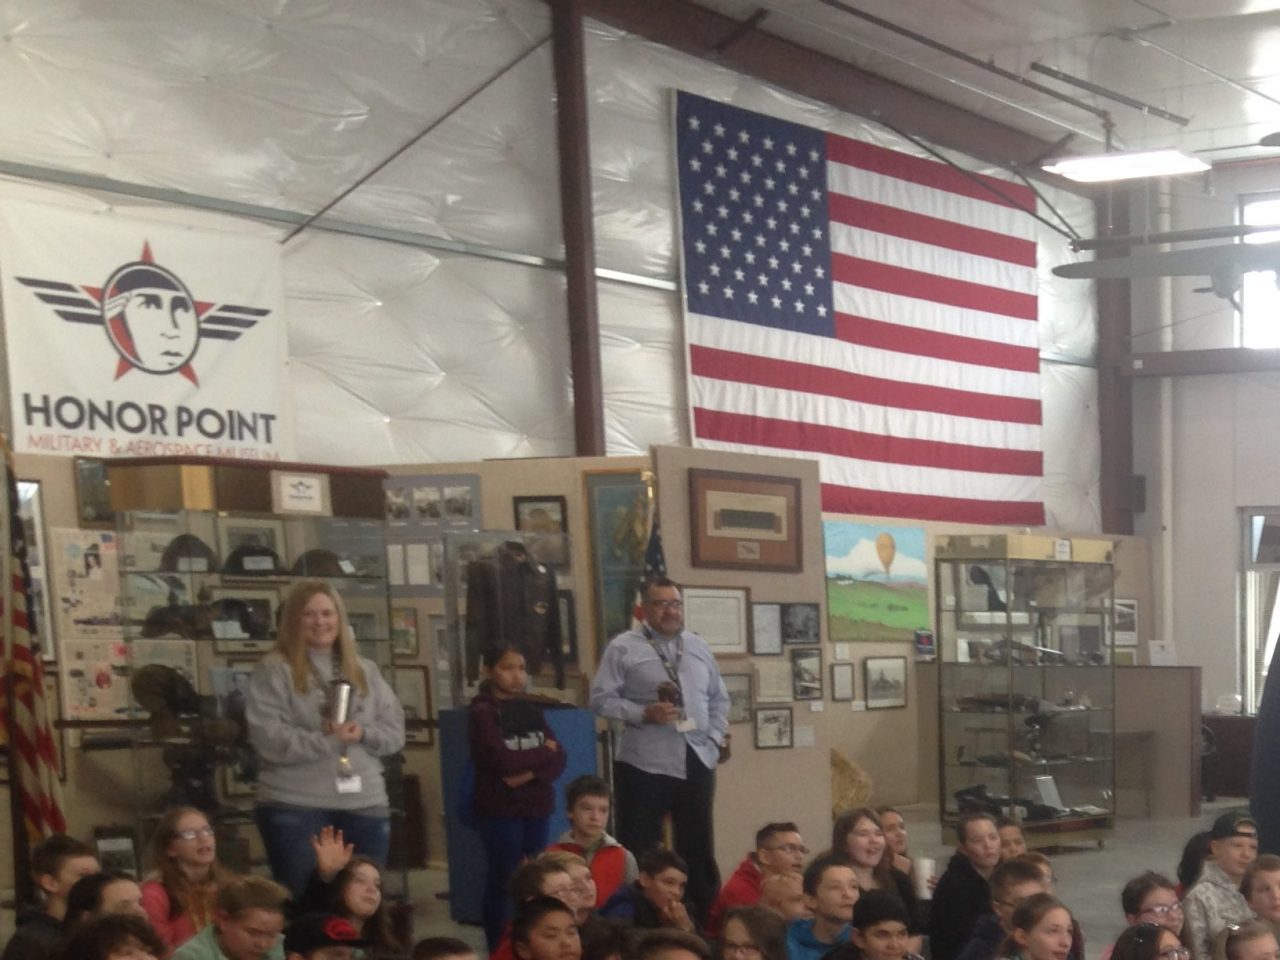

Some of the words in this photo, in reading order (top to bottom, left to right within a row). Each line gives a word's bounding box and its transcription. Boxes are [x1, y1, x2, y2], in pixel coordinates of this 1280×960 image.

[22, 393, 169, 436] HONOR
[177, 405, 277, 444] POINT
[27, 433, 103, 453] MILITARY
[110, 437, 121, 454] &
[127, 438, 211, 456] AEROSPACE
